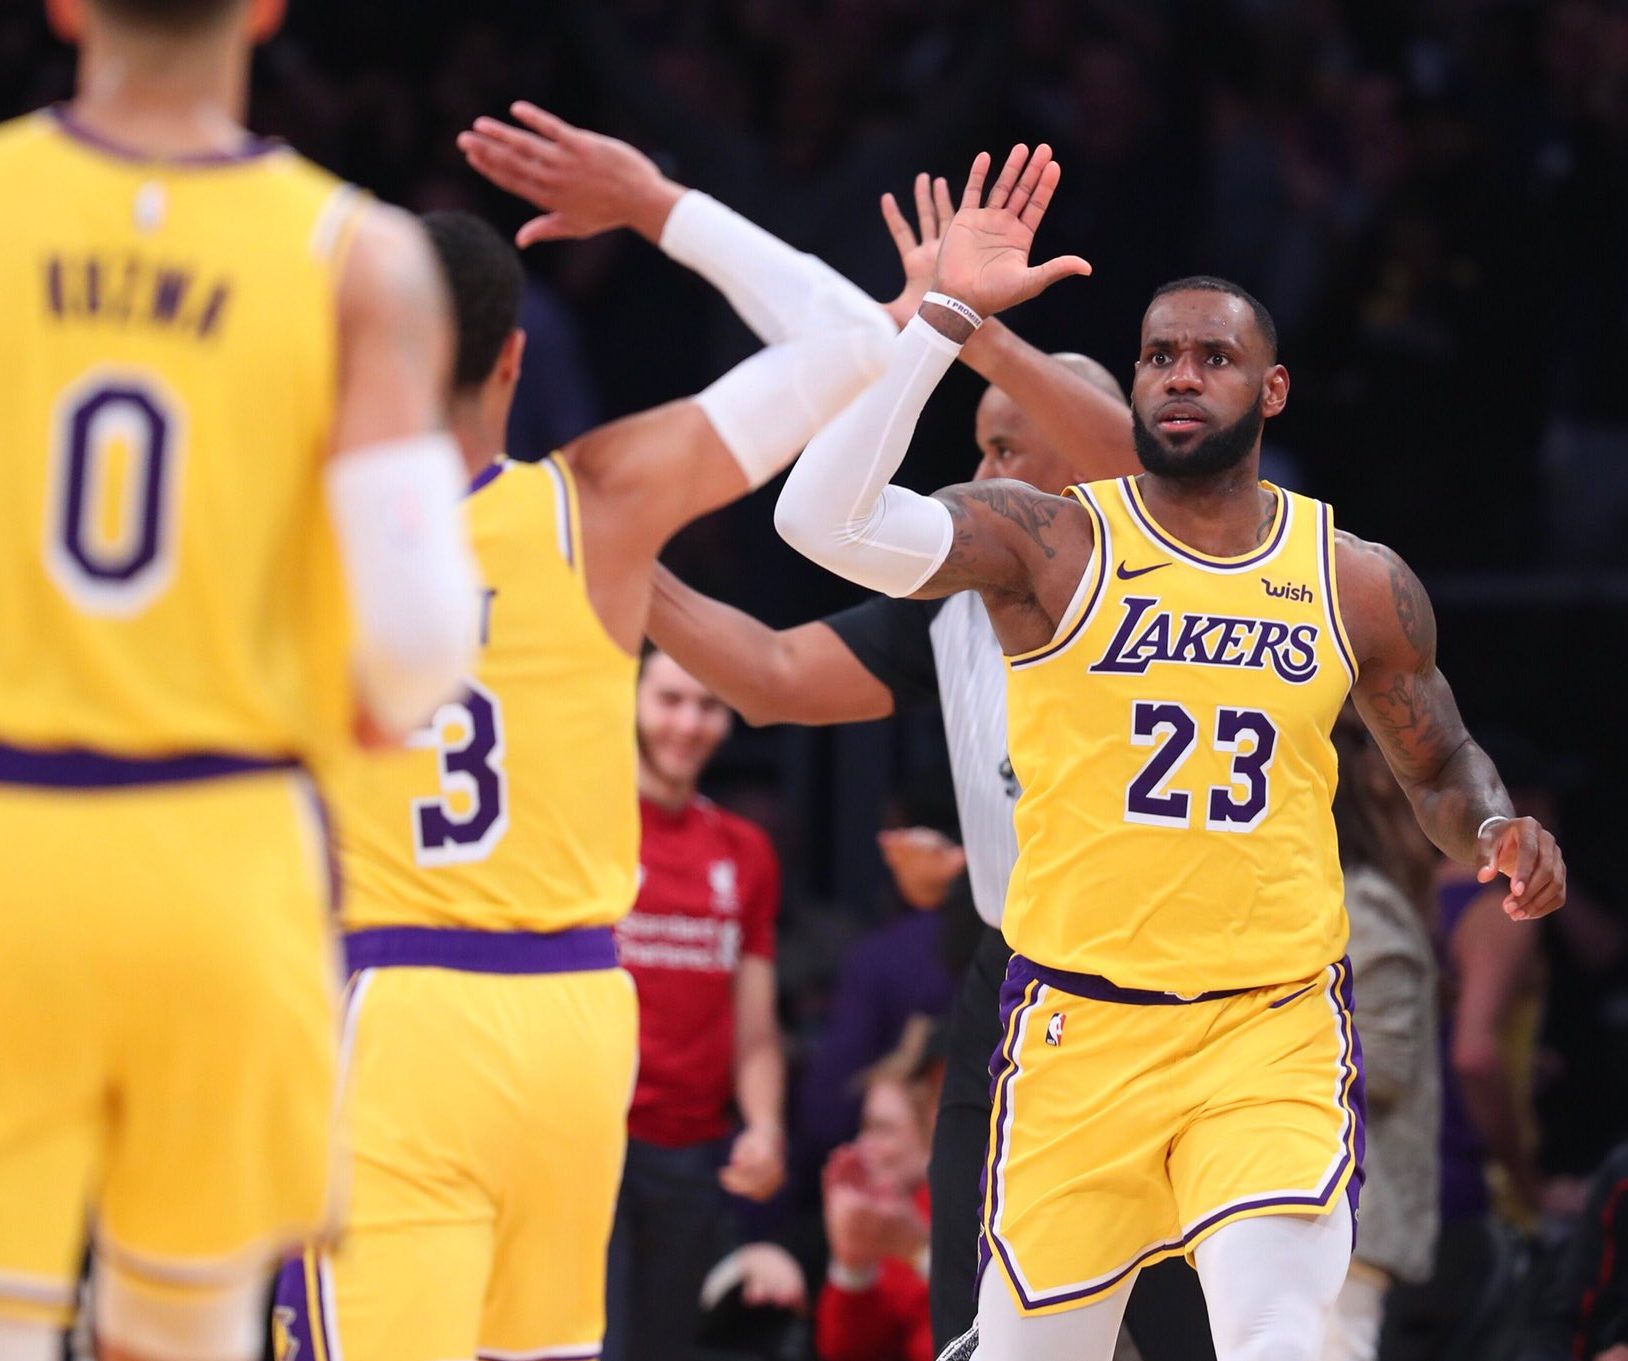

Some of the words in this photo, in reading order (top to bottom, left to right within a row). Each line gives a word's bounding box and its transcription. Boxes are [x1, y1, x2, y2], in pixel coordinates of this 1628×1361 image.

[48, 367, 184, 612] 0
[1088, 596, 1319, 684] LAKERS
[1260, 577, 1314, 604] wish
[409, 681, 508, 864] 3
[1124, 700, 1279, 833] 23
